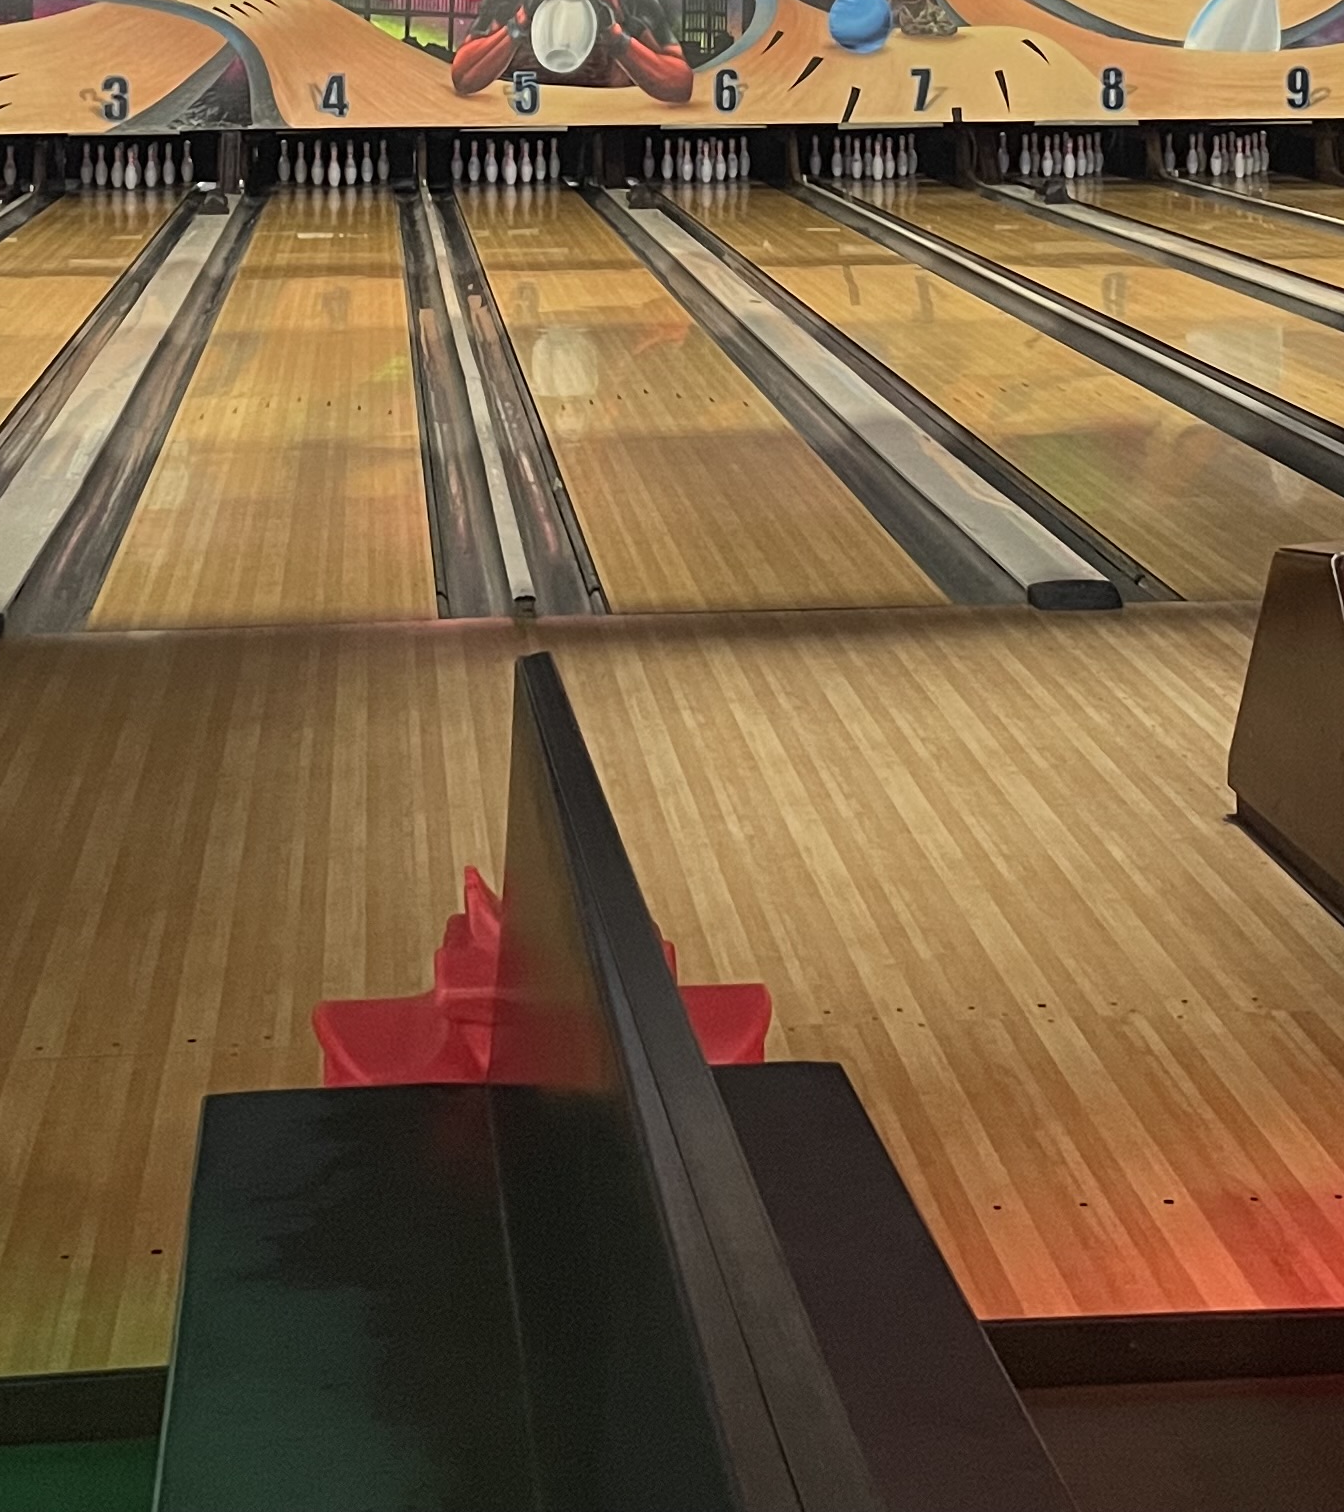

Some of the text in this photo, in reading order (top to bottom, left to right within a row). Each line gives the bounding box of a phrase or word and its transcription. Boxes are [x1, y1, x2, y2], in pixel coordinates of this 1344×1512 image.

[103, 76, 130, 123] 3
[321, 74, 350, 118] 4
[513, 71, 541, 116] 5
[714, 68, 739, 113] 6
[909, 67, 932, 113] 7
[1101, 66, 1126, 111] 8
[1286, 66, 1311, 110] 9
